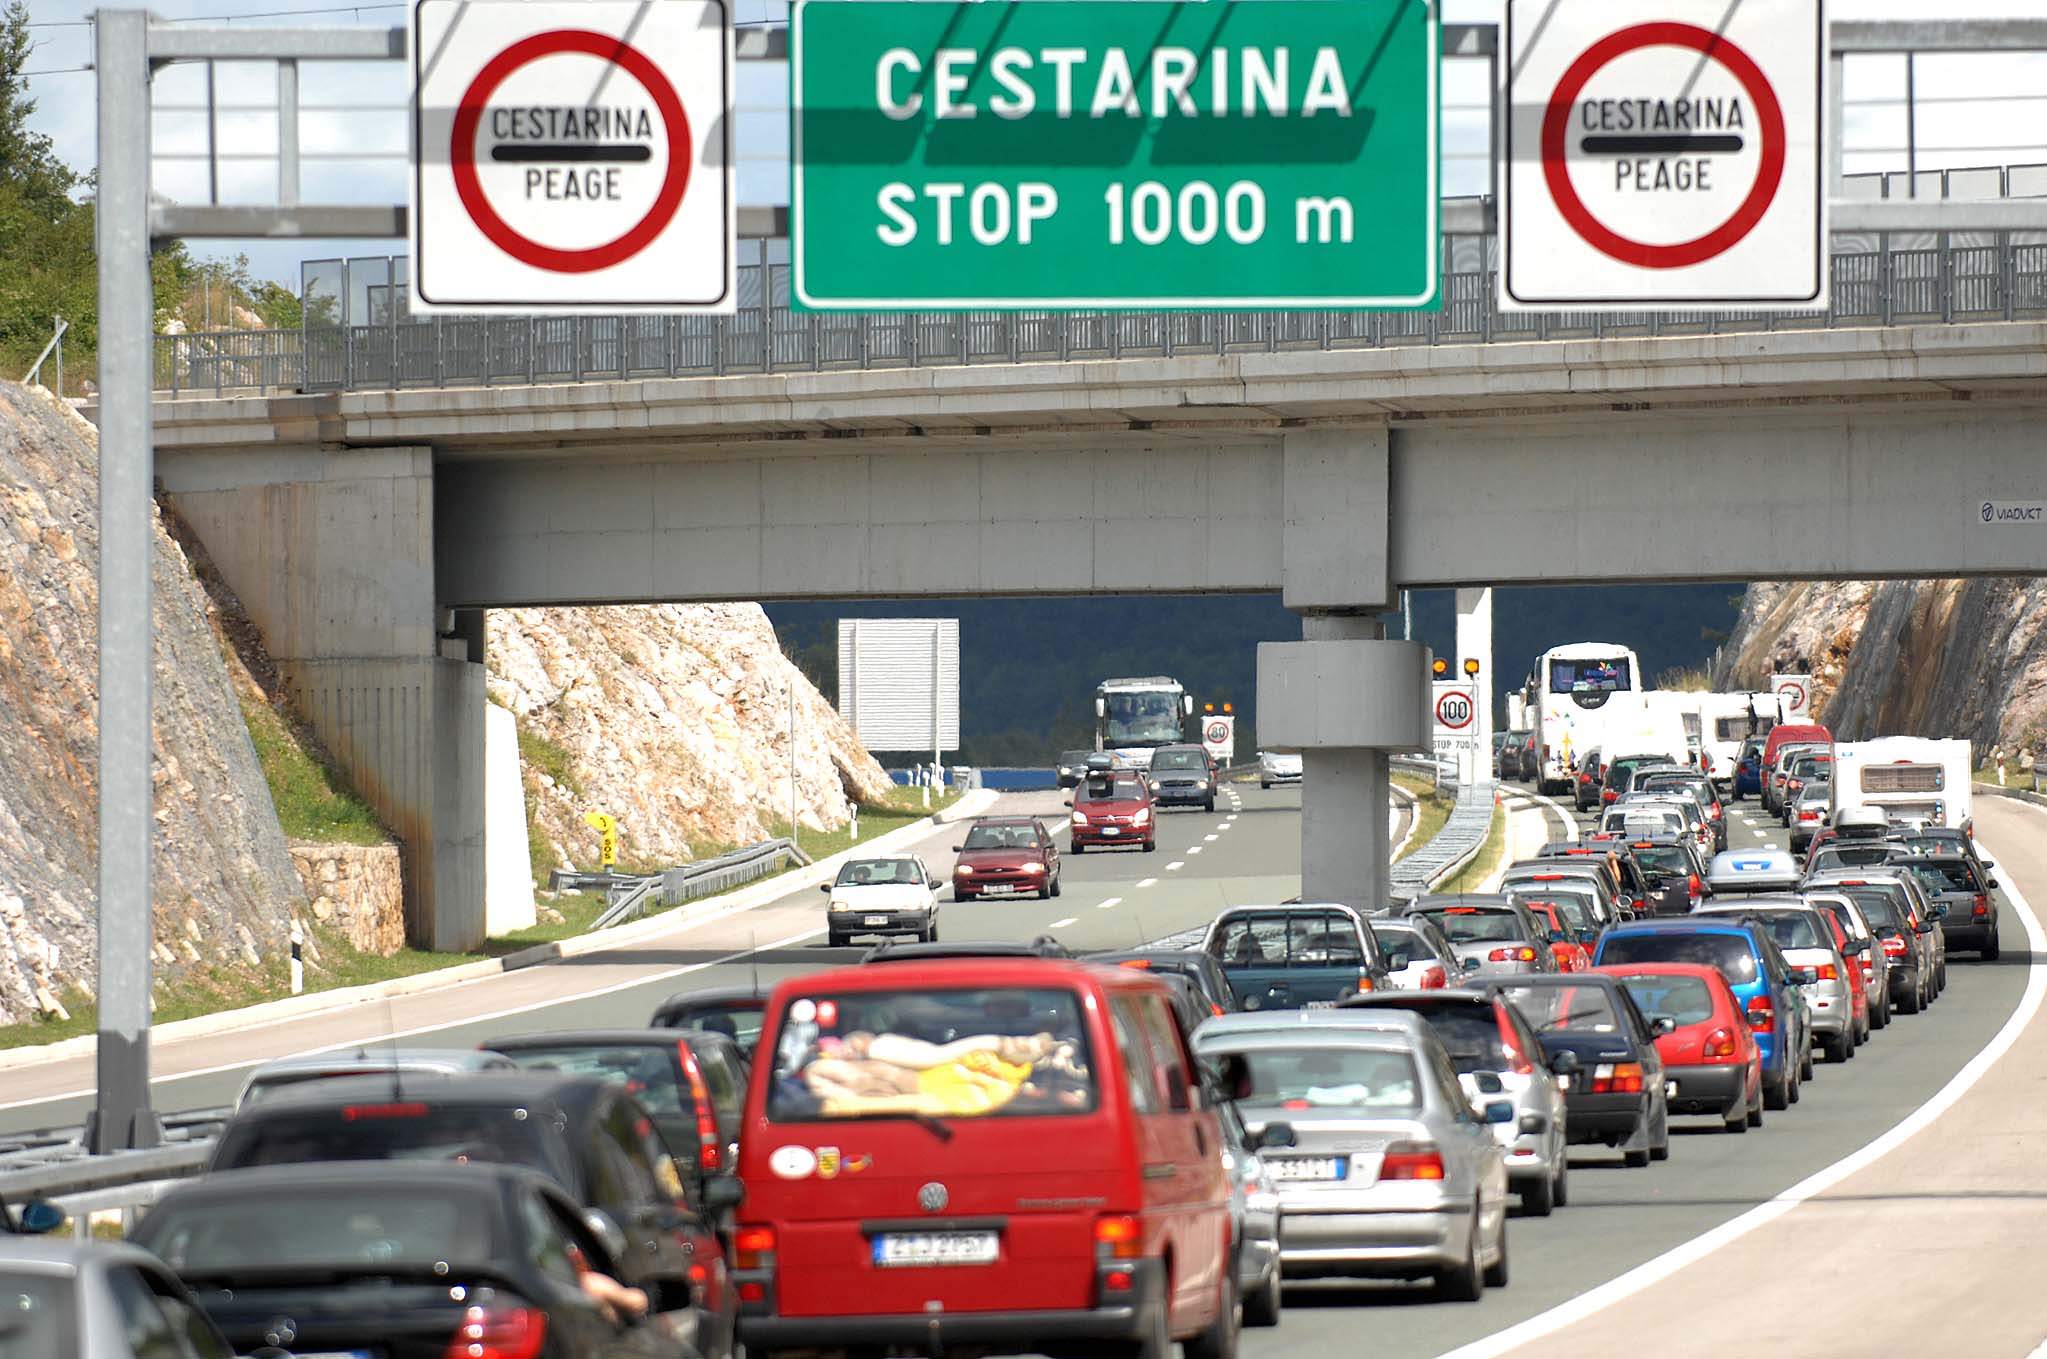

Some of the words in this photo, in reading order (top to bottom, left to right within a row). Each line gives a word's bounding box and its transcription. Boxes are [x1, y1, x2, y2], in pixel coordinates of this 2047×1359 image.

[876, 47, 1352, 119] CESTARINA
[492, 107, 654, 140] CESTARINA
[1582, 97, 1744, 131] CESTARINA
[525, 168, 623, 201] PEAGE
[1615, 159, 1711, 190] PEAGE
[876, 182, 1058, 246] STOP
[1105, 181, 1266, 245] 1000
[1295, 196, 1354, 243] m
[1443, 701, 1467, 719] 100
